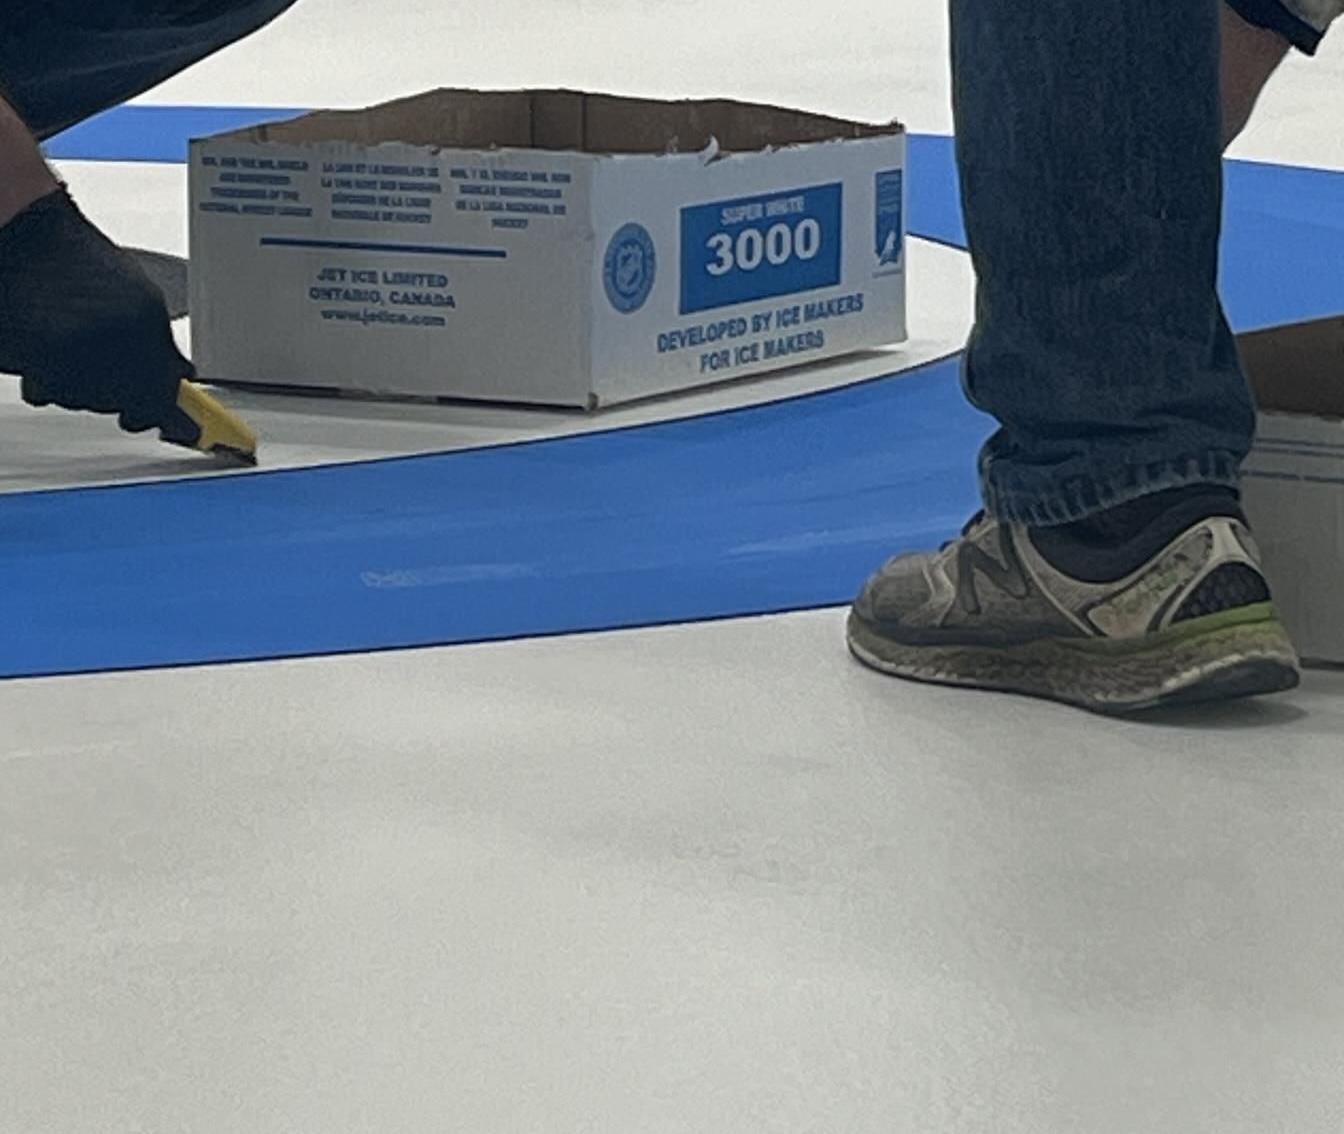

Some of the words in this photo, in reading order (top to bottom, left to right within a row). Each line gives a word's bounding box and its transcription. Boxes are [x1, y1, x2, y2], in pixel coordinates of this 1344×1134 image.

[720, 200, 763, 225] SUPER
[704, 217, 821, 277] 3000
[316, 267, 347, 282] JET
[351, 269, 378, 284] ICE
[382, 270, 449, 288] LIMITED
[309, 286, 385, 306] ONTARIO,
[389, 290, 456, 308] CANADA
[657, 317, 748, 354] DEVELOPED
[751, 313, 771, 334] BY
[775, 305, 801, 329] ICE
[804, 292, 865, 320] MAKERS
[699, 348, 732, 373] FOR
[734, 344, 760, 365] ICE
[763, 329, 825, 358] MAKERS
